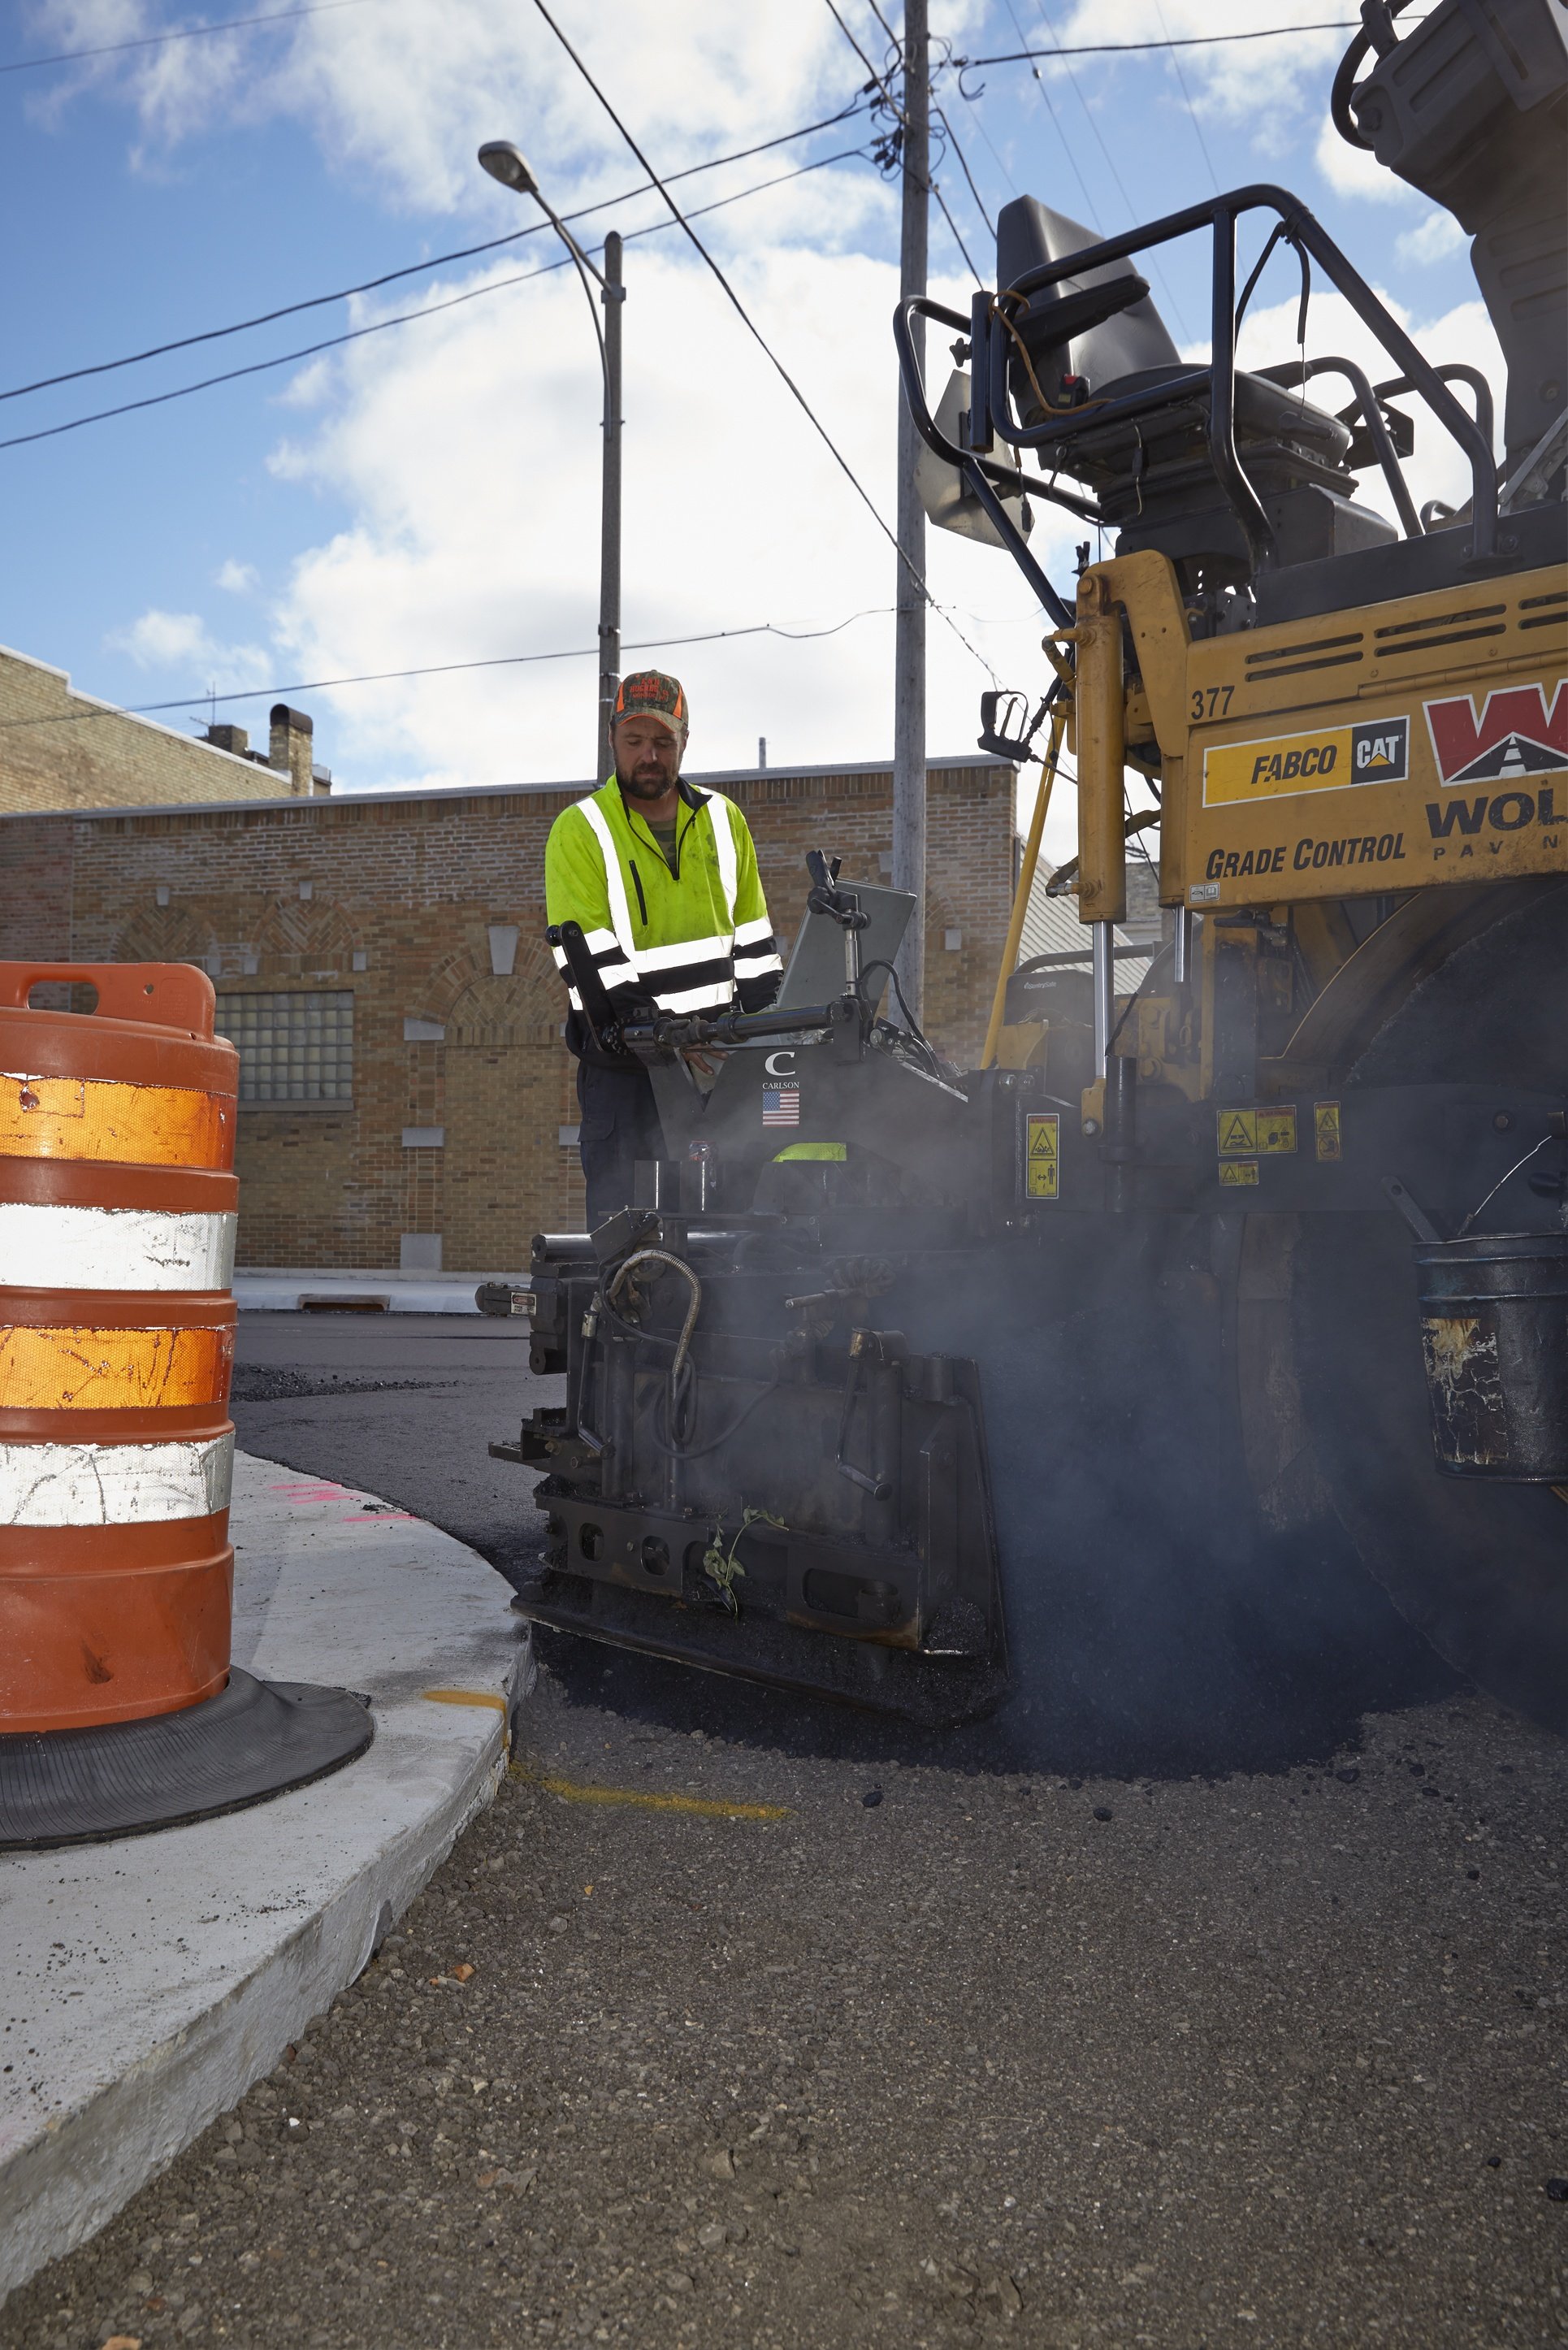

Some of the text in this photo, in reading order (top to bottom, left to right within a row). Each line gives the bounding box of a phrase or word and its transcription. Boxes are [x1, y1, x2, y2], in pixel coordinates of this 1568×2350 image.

[1191, 685, 1235, 720] 377
[1251, 735, 1400, 784] FABCO CAT
[1206, 833, 1406, 880] GRADE CONTROL
[765, 1051, 795, 1076] C
